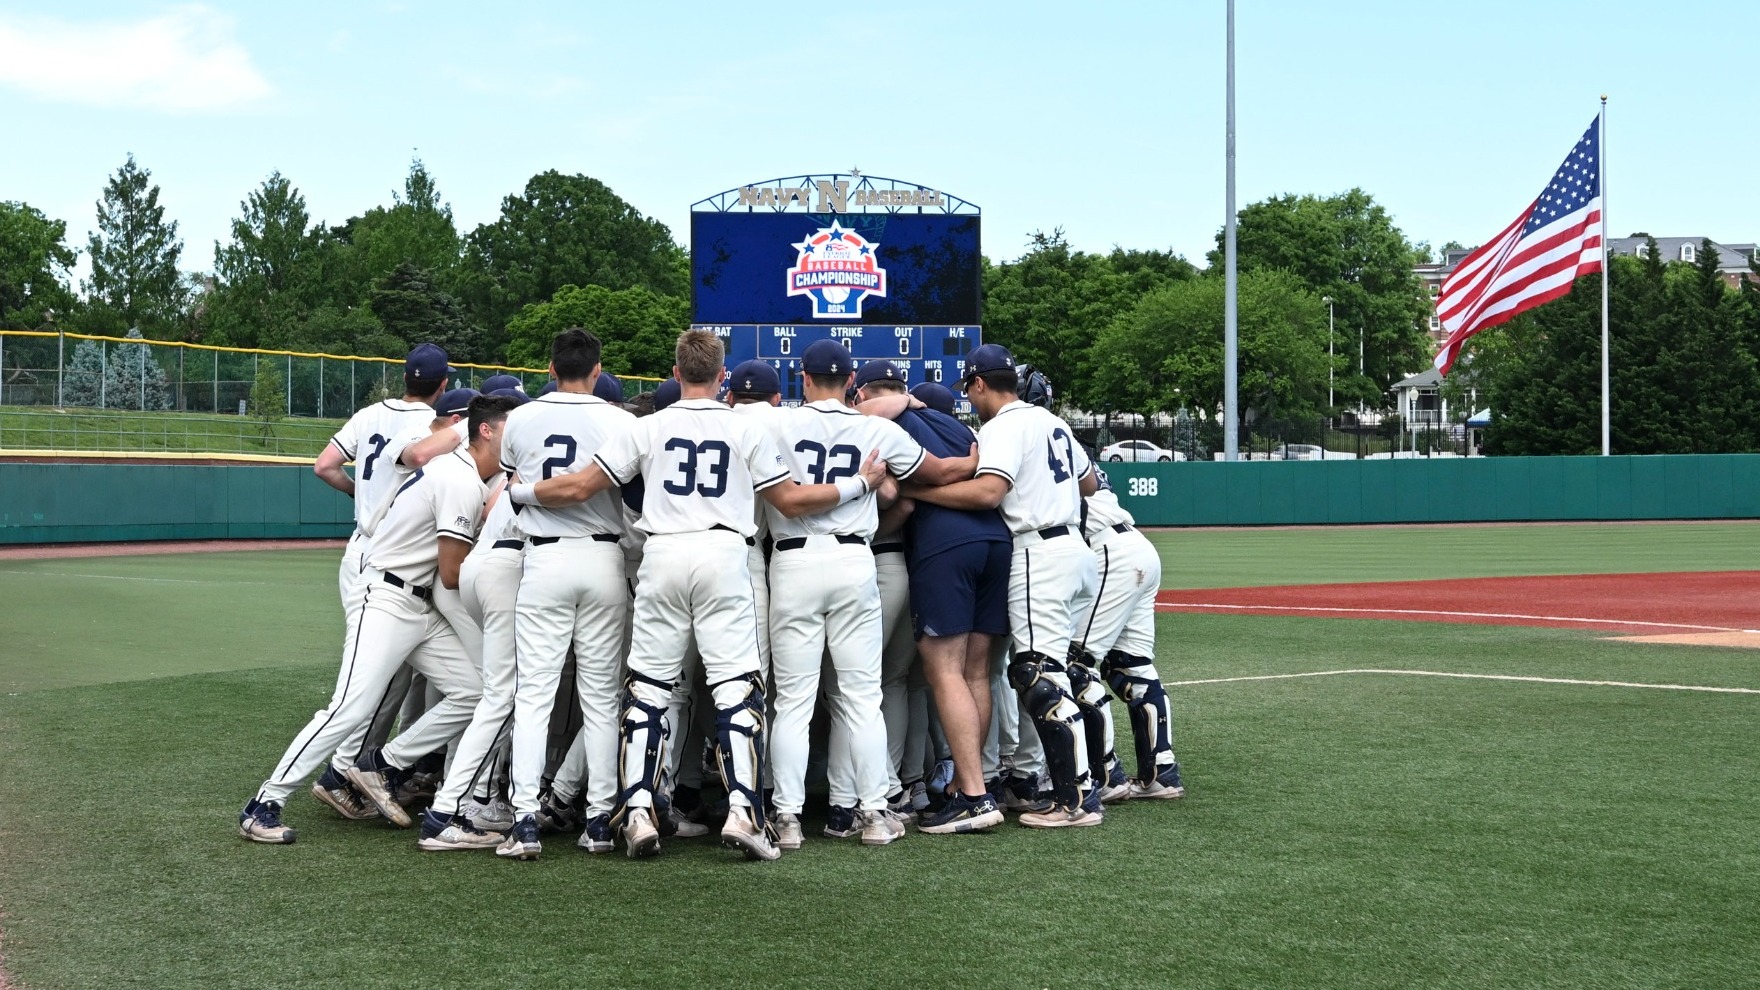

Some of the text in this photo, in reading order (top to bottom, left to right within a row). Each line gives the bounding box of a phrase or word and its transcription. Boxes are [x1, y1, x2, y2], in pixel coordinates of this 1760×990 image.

[738, 180, 945, 213] NAVY N BASEBALL
[807, 261, 867, 271] BASEBALL
[795, 271, 878, 287] CHAMPIONSHIP
[827, 304, 846, 313] 2024
[714, 327, 732, 337] BAT
[773, 327, 797, 337] BALL
[830, 327, 863, 337] STRIKE
[894, 327, 914, 337] OUT
[949, 327, 965, 338] H/E
[780, 337, 791, 354] 0
[899, 338, 909, 355] 0
[774, 360, 781, 369] 3
[789, 360, 795, 369] 4
[924, 360, 943, 369] HITS
[934, 369, 943, 382] 0
[542, 434, 578, 479] 2
[794, 439, 862, 484] 32
[663, 437, 730, 498] 33
[1128, 477, 1158, 497] 388
